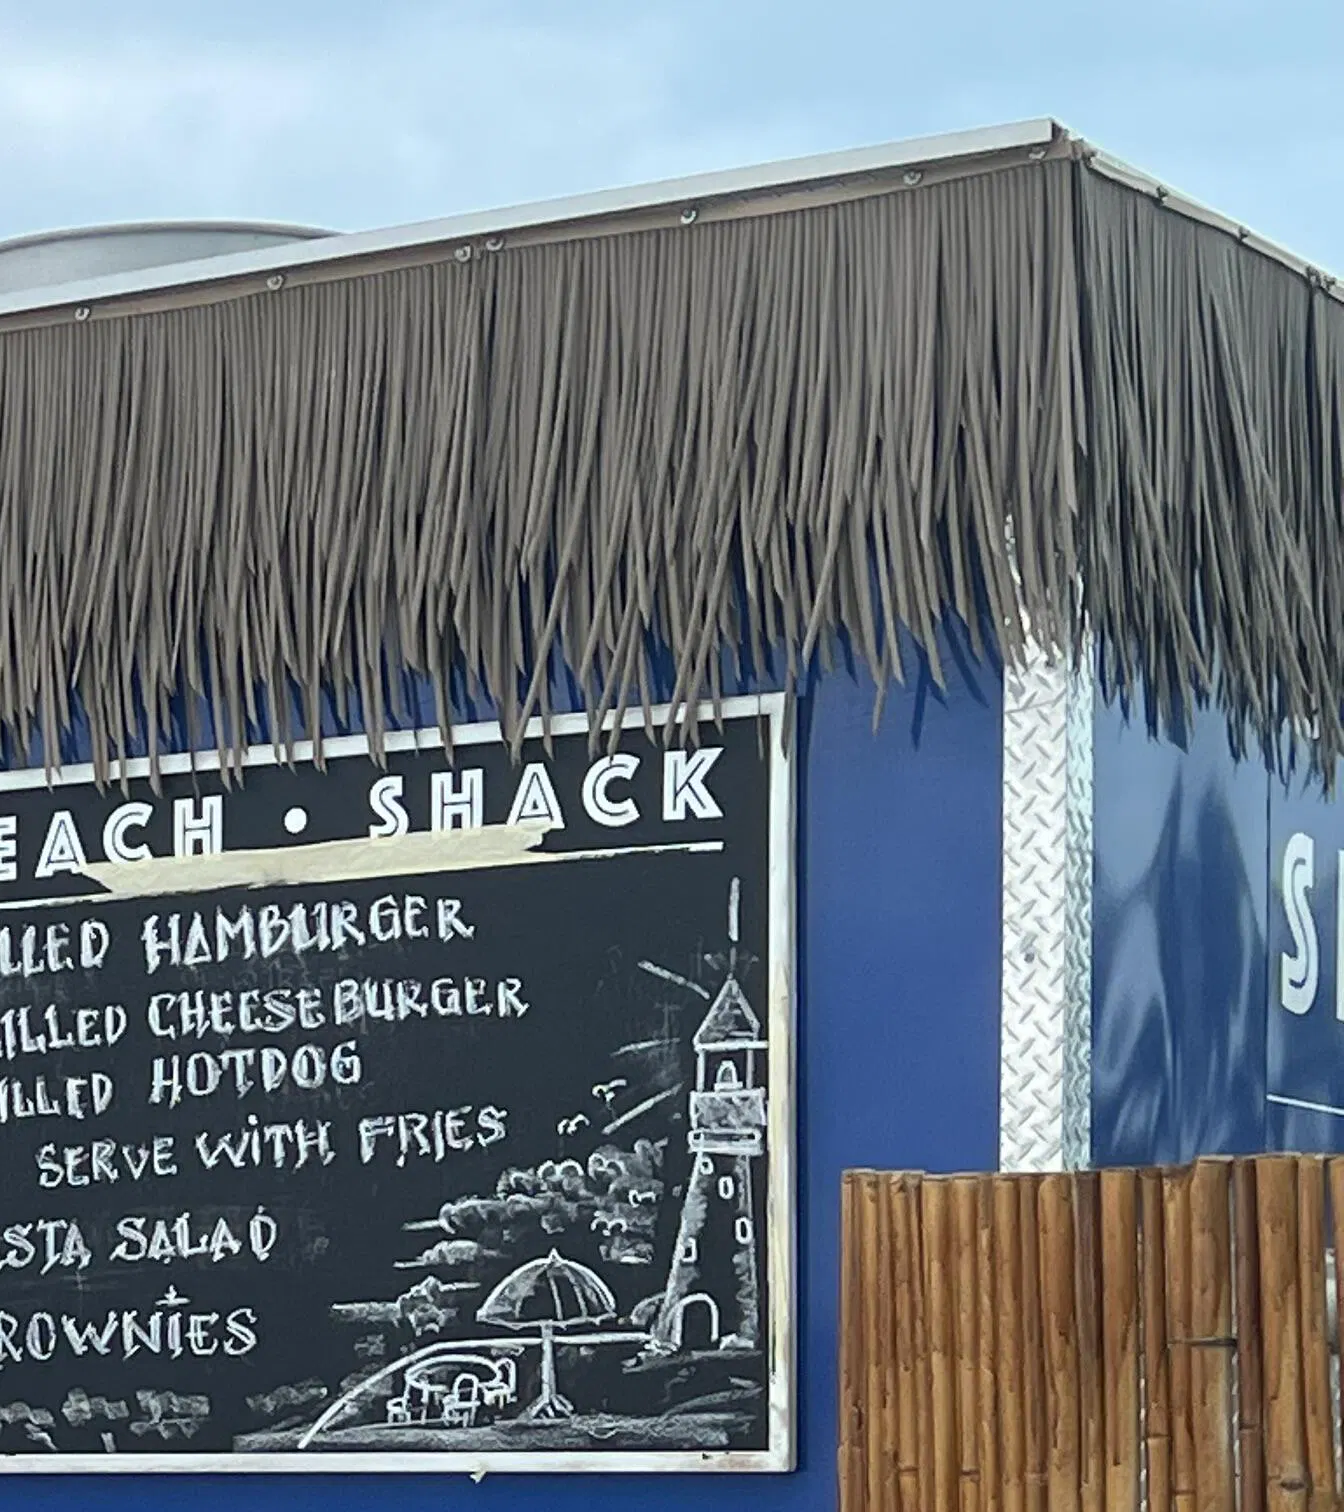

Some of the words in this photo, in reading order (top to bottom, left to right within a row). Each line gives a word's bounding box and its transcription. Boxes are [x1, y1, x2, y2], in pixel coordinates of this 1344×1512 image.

[369, 748, 723, 840] SHACK
[140, 894, 475, 974] HAMBURGER
[1281, 832, 1344, 1022] S
[149, 1041, 361, 1109] HOTDOG
[36, 1138, 178, 1188] SERVE
[359, 1106, 508, 1168] FRIES
[110, 1206, 277, 1264] SALAD
